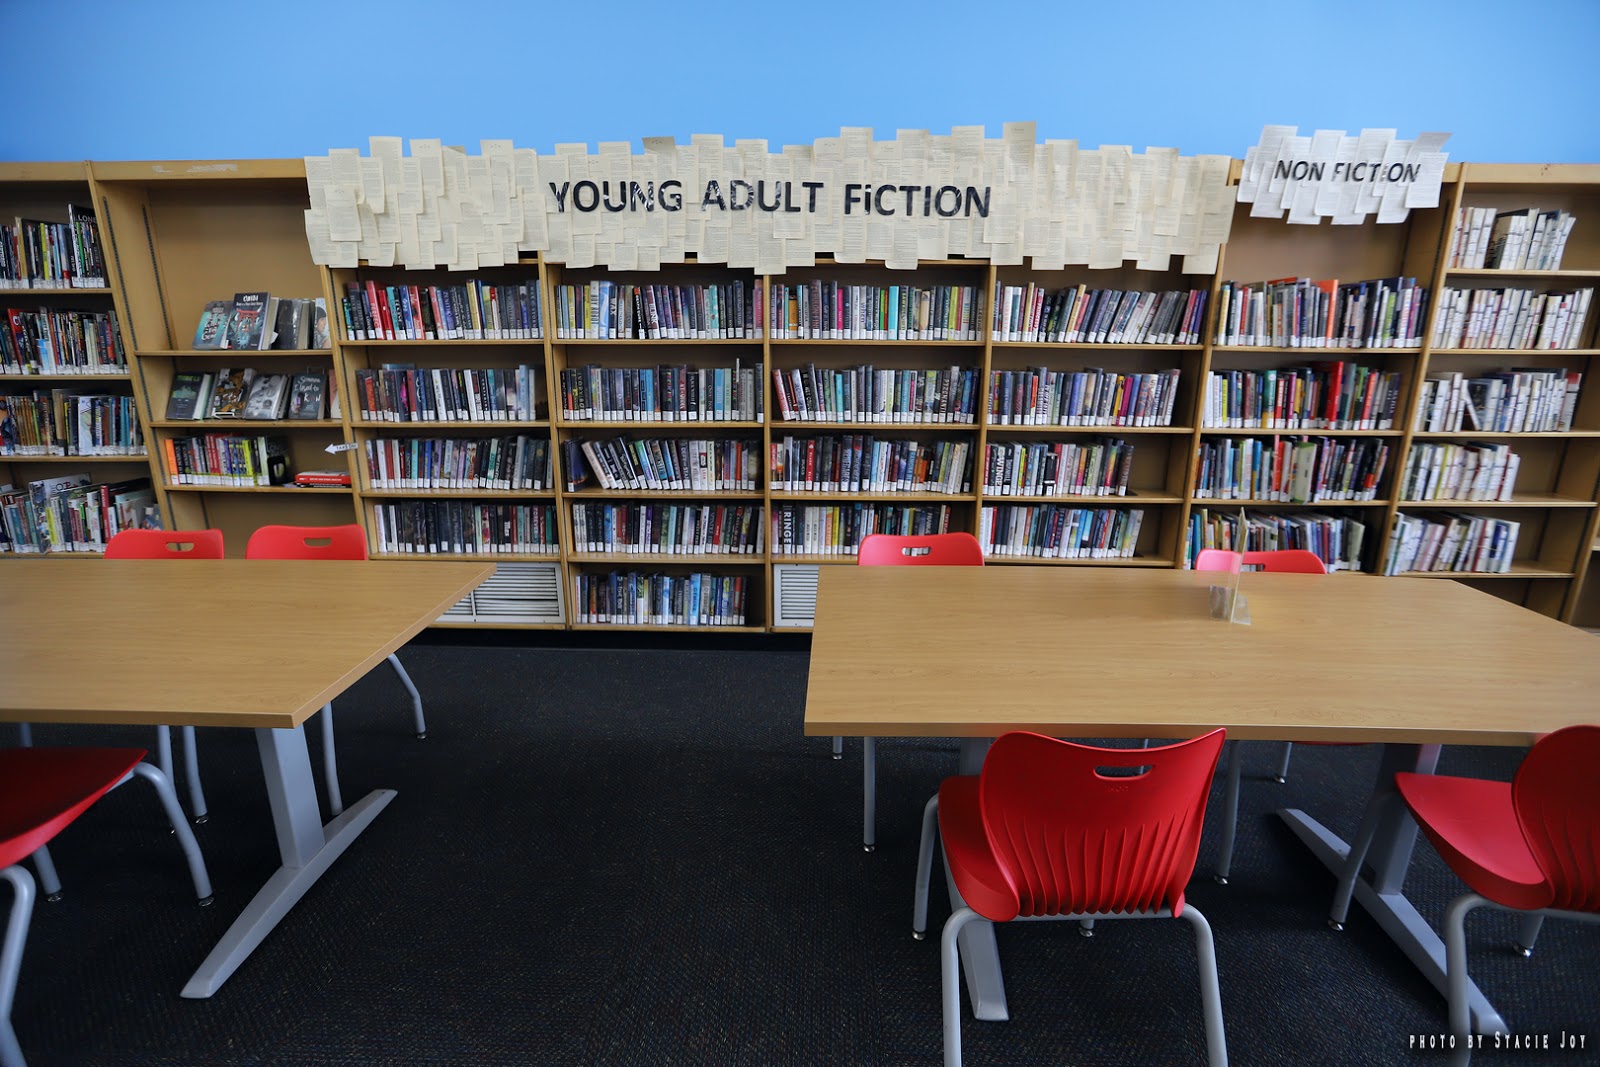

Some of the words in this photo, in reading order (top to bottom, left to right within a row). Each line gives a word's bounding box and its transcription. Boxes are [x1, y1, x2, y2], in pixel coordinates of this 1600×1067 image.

[1274, 160, 1325, 181] NON
[1331, 162, 1421, 183] FICTION
[549, 180, 682, 213] YOUNG
[701, 180, 824, 212] ADULT
[609, 297, 617, 315] WAX
[648, 303, 658, 324] BLINK
[1138, 382, 1151, 406] DRY
[783, 511, 793, 544] RINGE
